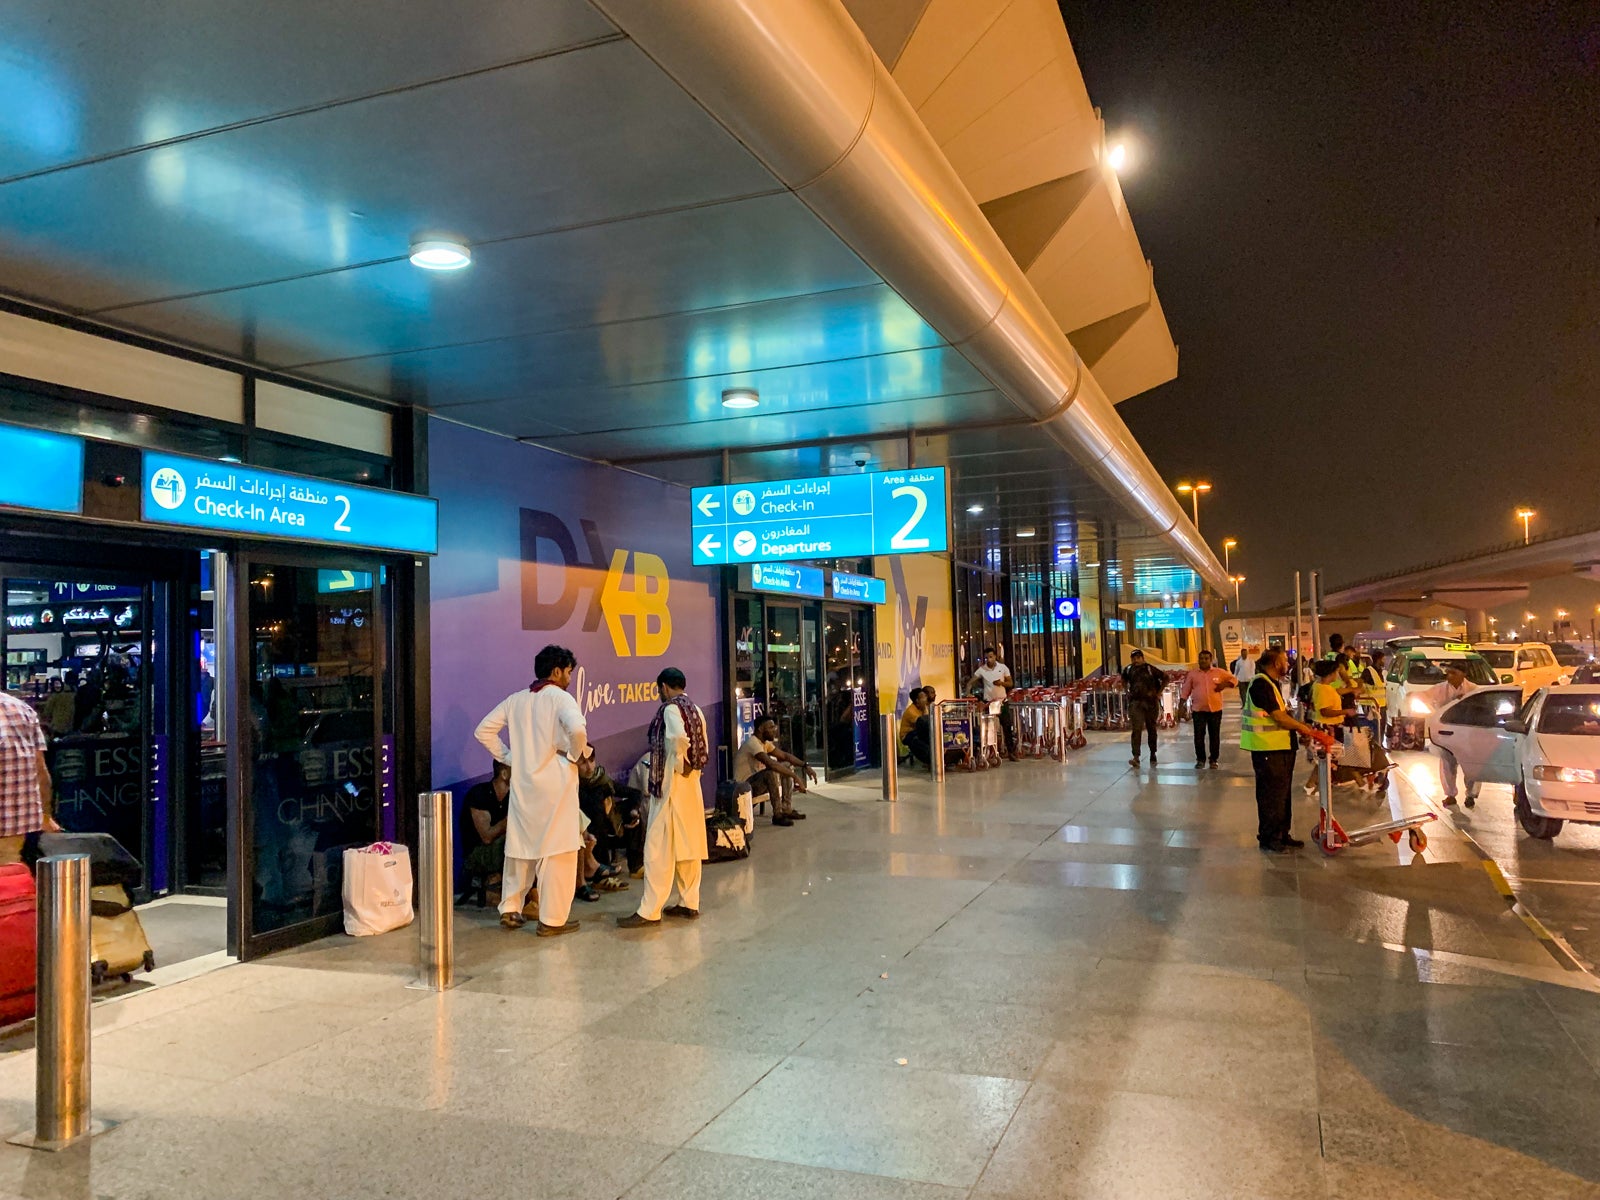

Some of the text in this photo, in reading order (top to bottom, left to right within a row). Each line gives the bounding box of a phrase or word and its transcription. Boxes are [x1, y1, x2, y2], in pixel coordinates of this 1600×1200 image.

[883, 475, 905, 484] Area
[909, 474, 935, 484] منطقة
[194, 473, 328, 505] منطقة إجراءات السفر
[761, 481, 831, 500] إجراءات السفر
[194, 496, 305, 526] Check-In Area
[333, 495, 352, 532] 2
[761, 501, 815, 515] Check-In
[890, 485, 930, 550] 2
[761, 524, 811, 540] المغادرون
[761, 541, 832, 557] Departures
[795, 570, 802, 589] 2
[864, 581, 870, 598] 2
[7, 614, 34, 627] vice
[114, 604, 133, 626] في
[877, 643, 894, 659] AND.
[617, 681, 660, 703] TAKEO
[54, 780, 158, 816] HANG
